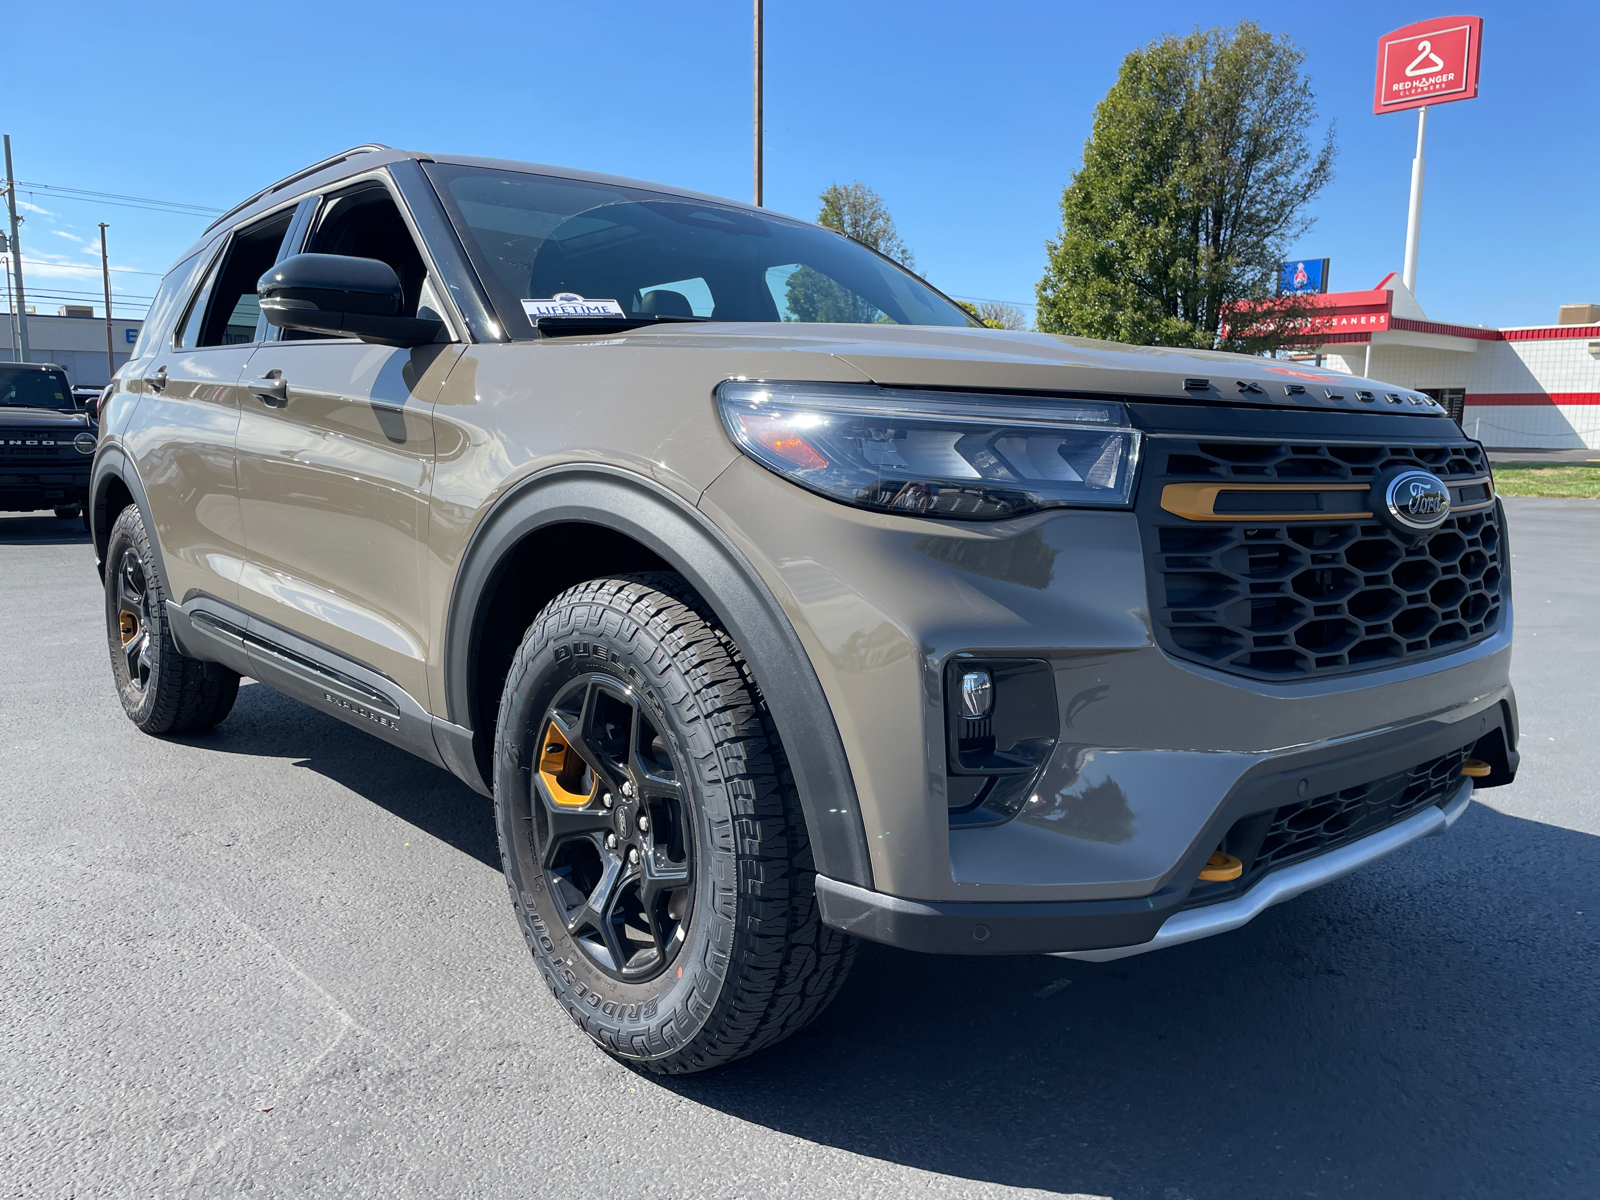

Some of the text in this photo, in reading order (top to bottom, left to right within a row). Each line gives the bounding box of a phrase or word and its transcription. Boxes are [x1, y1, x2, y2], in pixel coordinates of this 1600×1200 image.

[1392, 81, 1411, 92] RED
[1399, 83, 1446, 96] CLEANERS
[536, 305, 612, 314] LIFETIME
[1408, 482, 1443, 514] Ford
